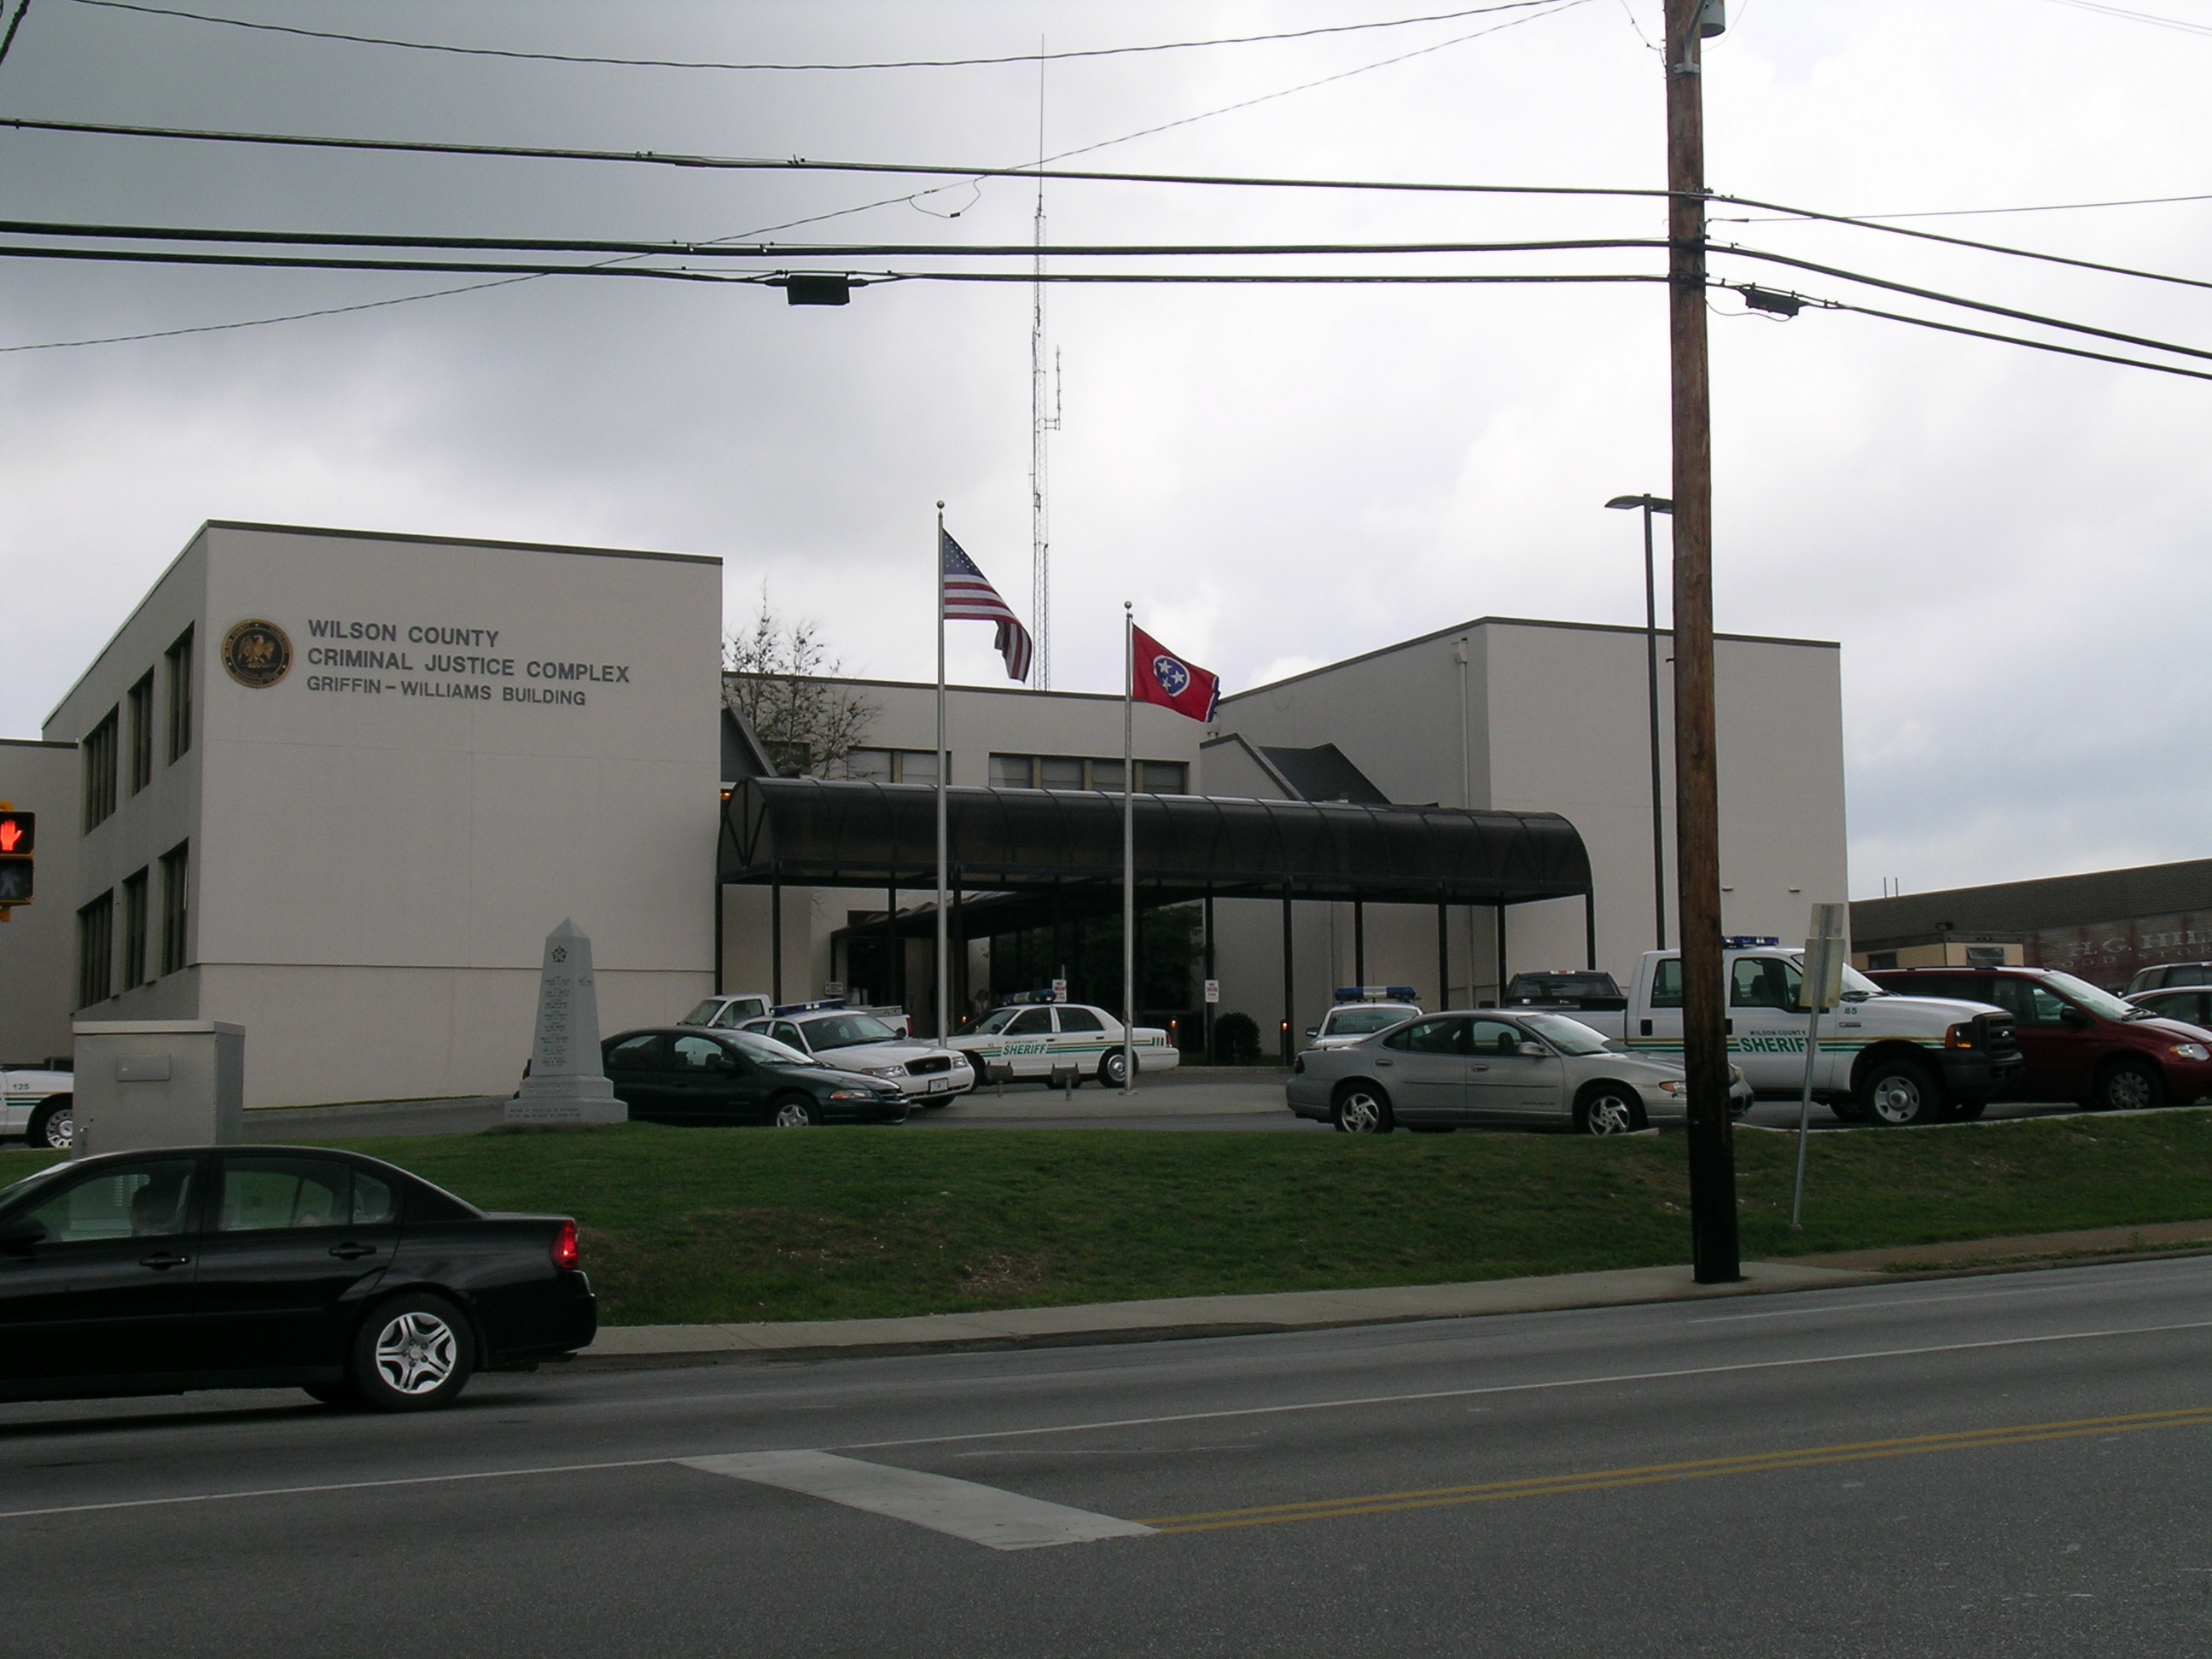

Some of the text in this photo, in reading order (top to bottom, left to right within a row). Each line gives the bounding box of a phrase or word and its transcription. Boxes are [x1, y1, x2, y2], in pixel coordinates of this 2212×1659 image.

[308, 619, 499, 648] WILSON COUNTY
[307, 647, 630, 683] CRIMINAL JUSTICE COMPLEX
[503, 686, 586, 707] BUILDING
[1003, 1044, 1046, 1056] SHERIFF
